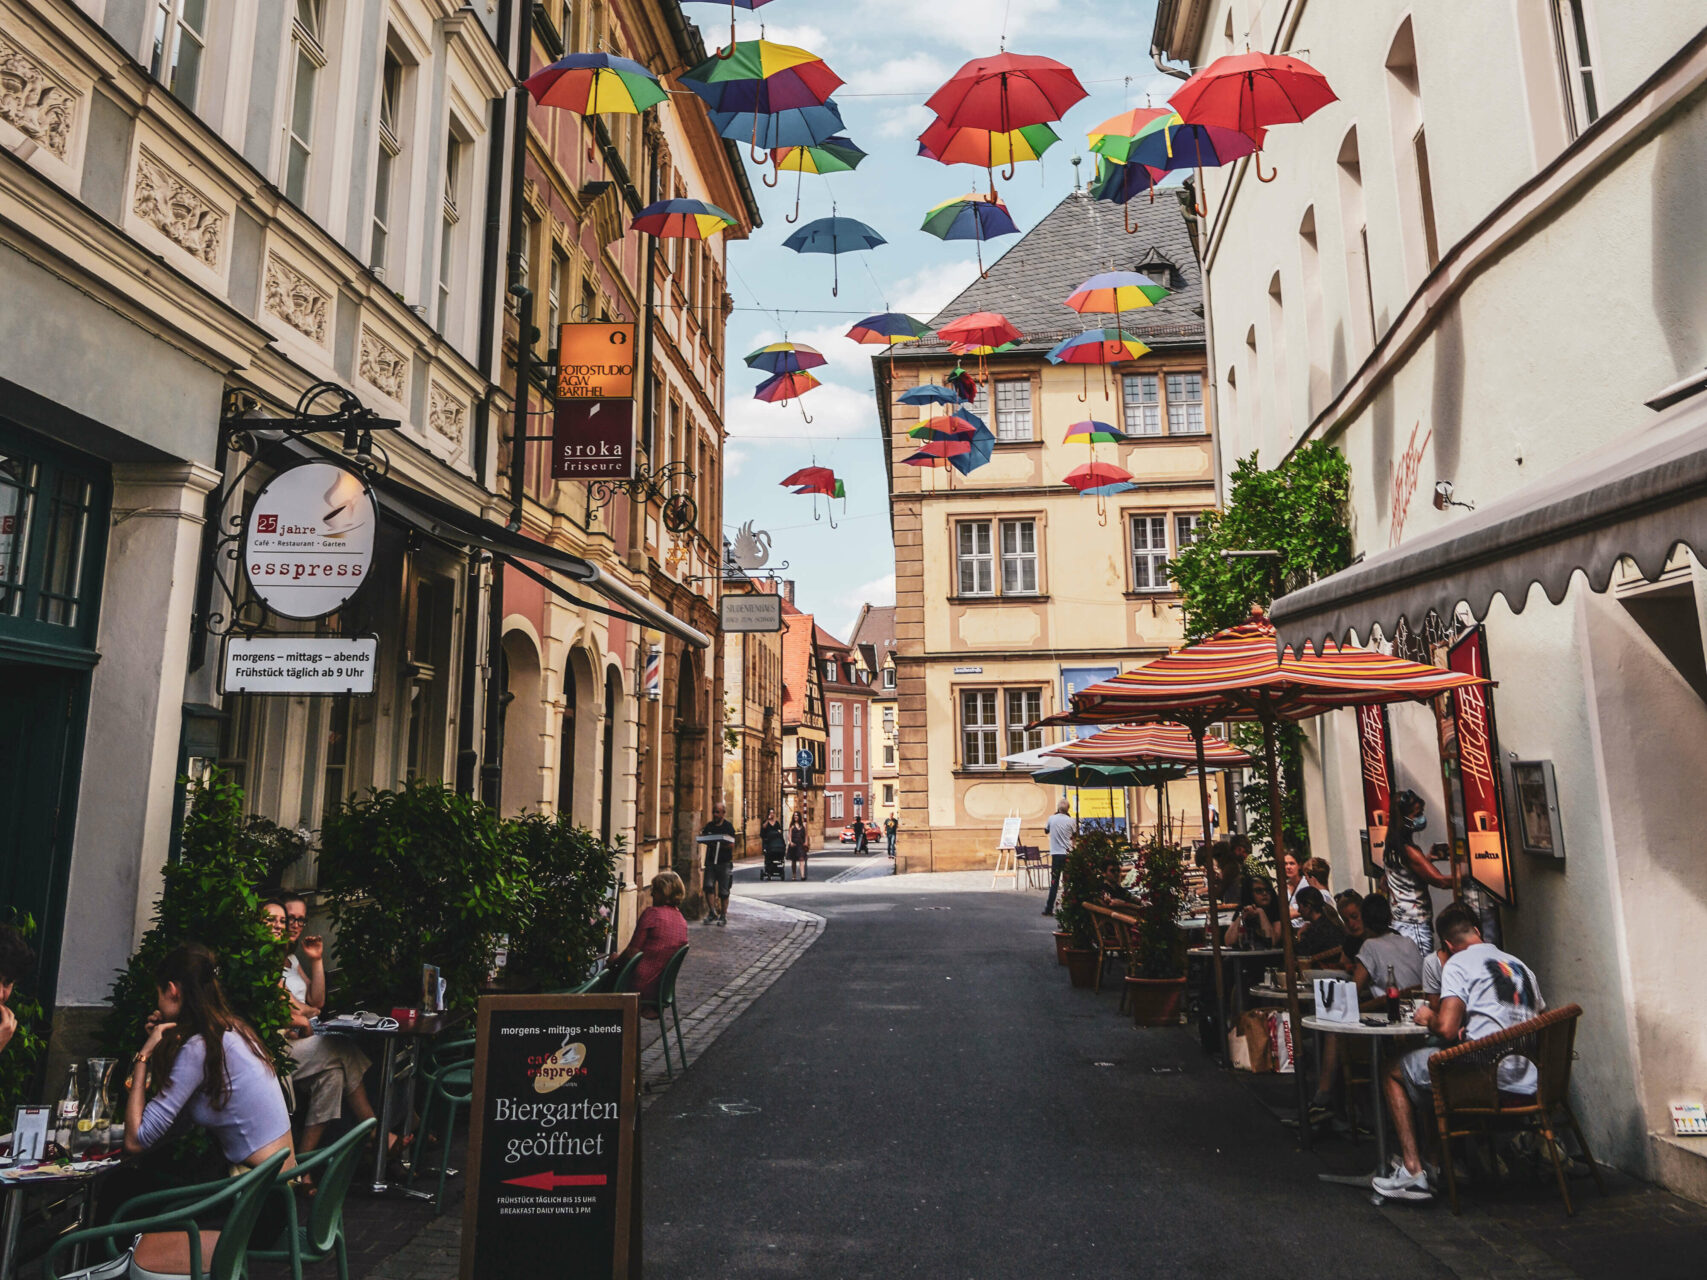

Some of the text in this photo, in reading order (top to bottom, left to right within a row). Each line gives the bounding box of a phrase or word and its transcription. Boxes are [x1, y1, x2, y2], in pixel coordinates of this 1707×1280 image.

[559, 386, 604, 396] BARTHEL
[564, 441, 622, 456] sroka
[564, 462, 622, 471] friseure
[258, 517, 316, 536] 25 jahre
[251, 563, 362, 579] esspress
[232, 652, 370, 663] morgens mittags abends
[235, 667, 364, 679] Frühstück täglich ab 9 Uhr
[501, 1025, 622, 1036] morgens mittags abends
[527, 1067, 588, 1080] esspress
[494, 1097, 619, 1127] Biergarten
[504, 1131, 605, 1163] geöffnet
[497, 1196, 534, 1204] FRÜHSTÜCK
[536, 1195, 561, 1203] TÄGLICH
